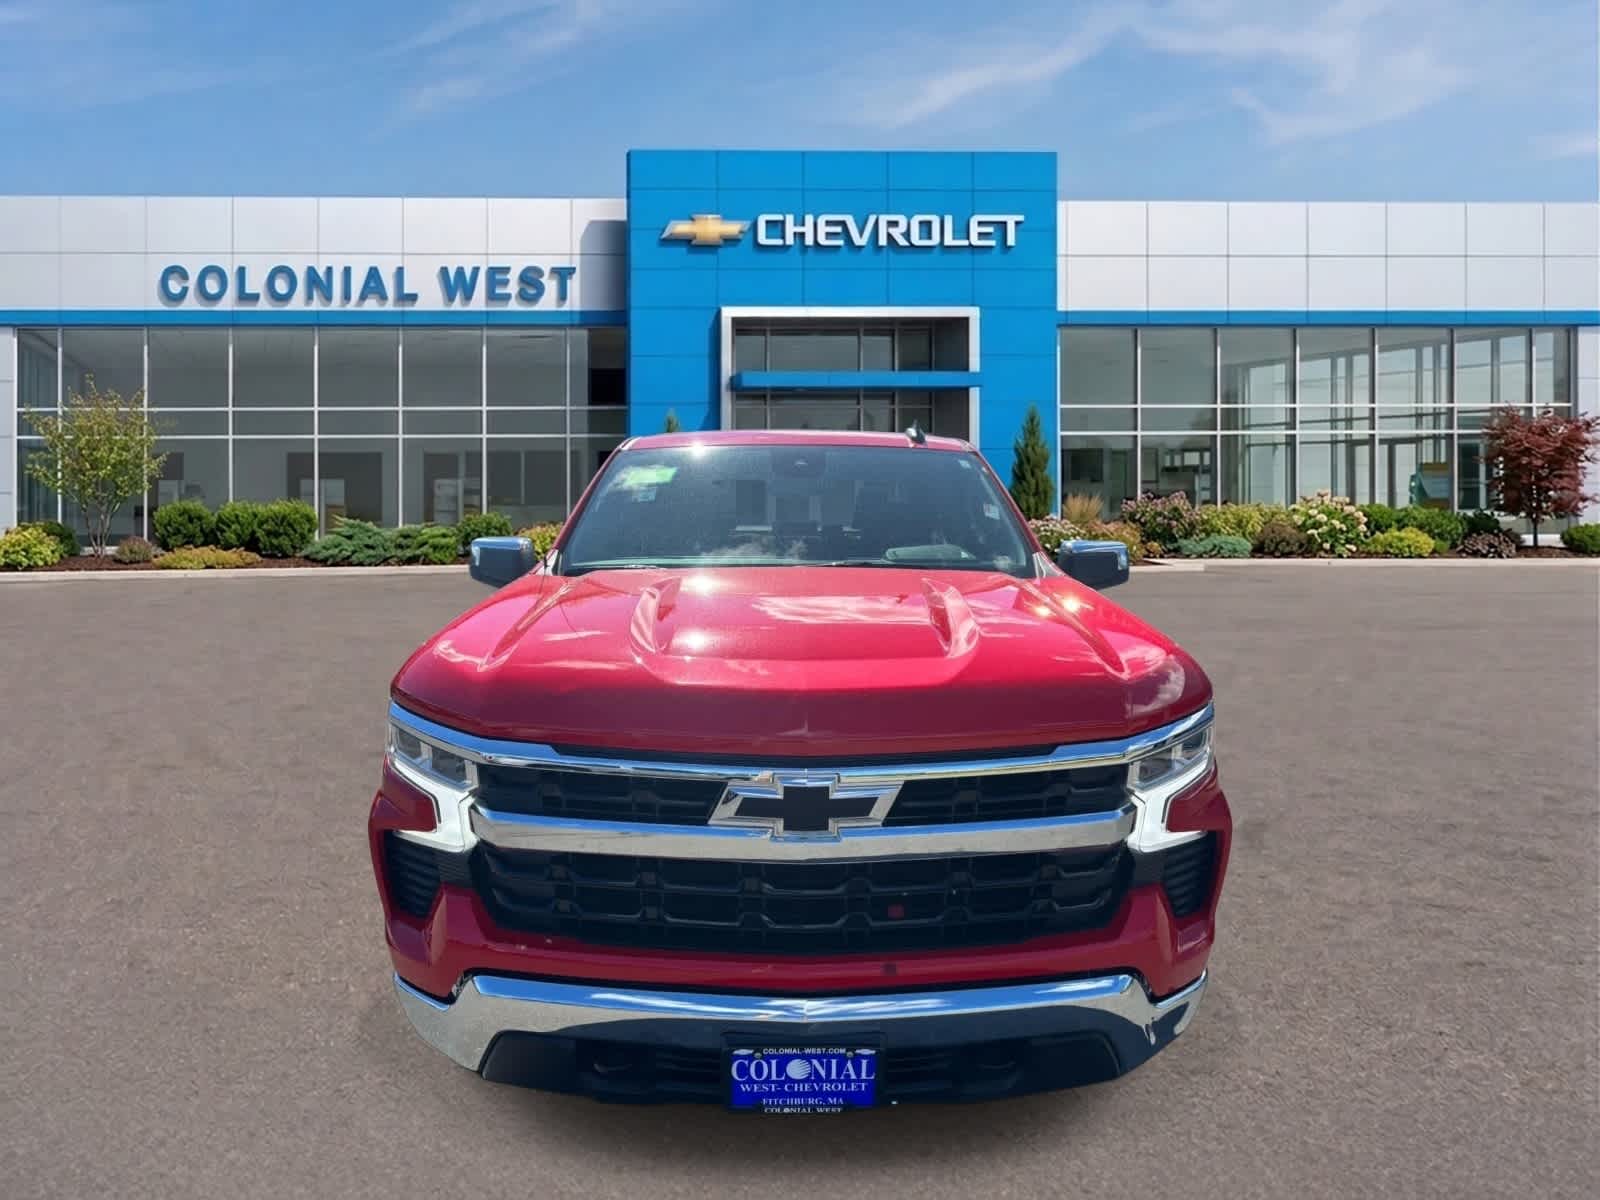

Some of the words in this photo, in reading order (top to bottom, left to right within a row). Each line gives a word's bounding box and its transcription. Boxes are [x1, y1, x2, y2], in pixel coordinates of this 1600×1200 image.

[756, 213, 1025, 248] CHEVROLET
[159, 264, 419, 303] COLONIAL
[437, 265, 577, 303] WEST
[731, 1058, 875, 1081] COLONIAL
[784, 1082, 868, 1093] CHEVROLET
[828, 1097, 845, 1106] MA
